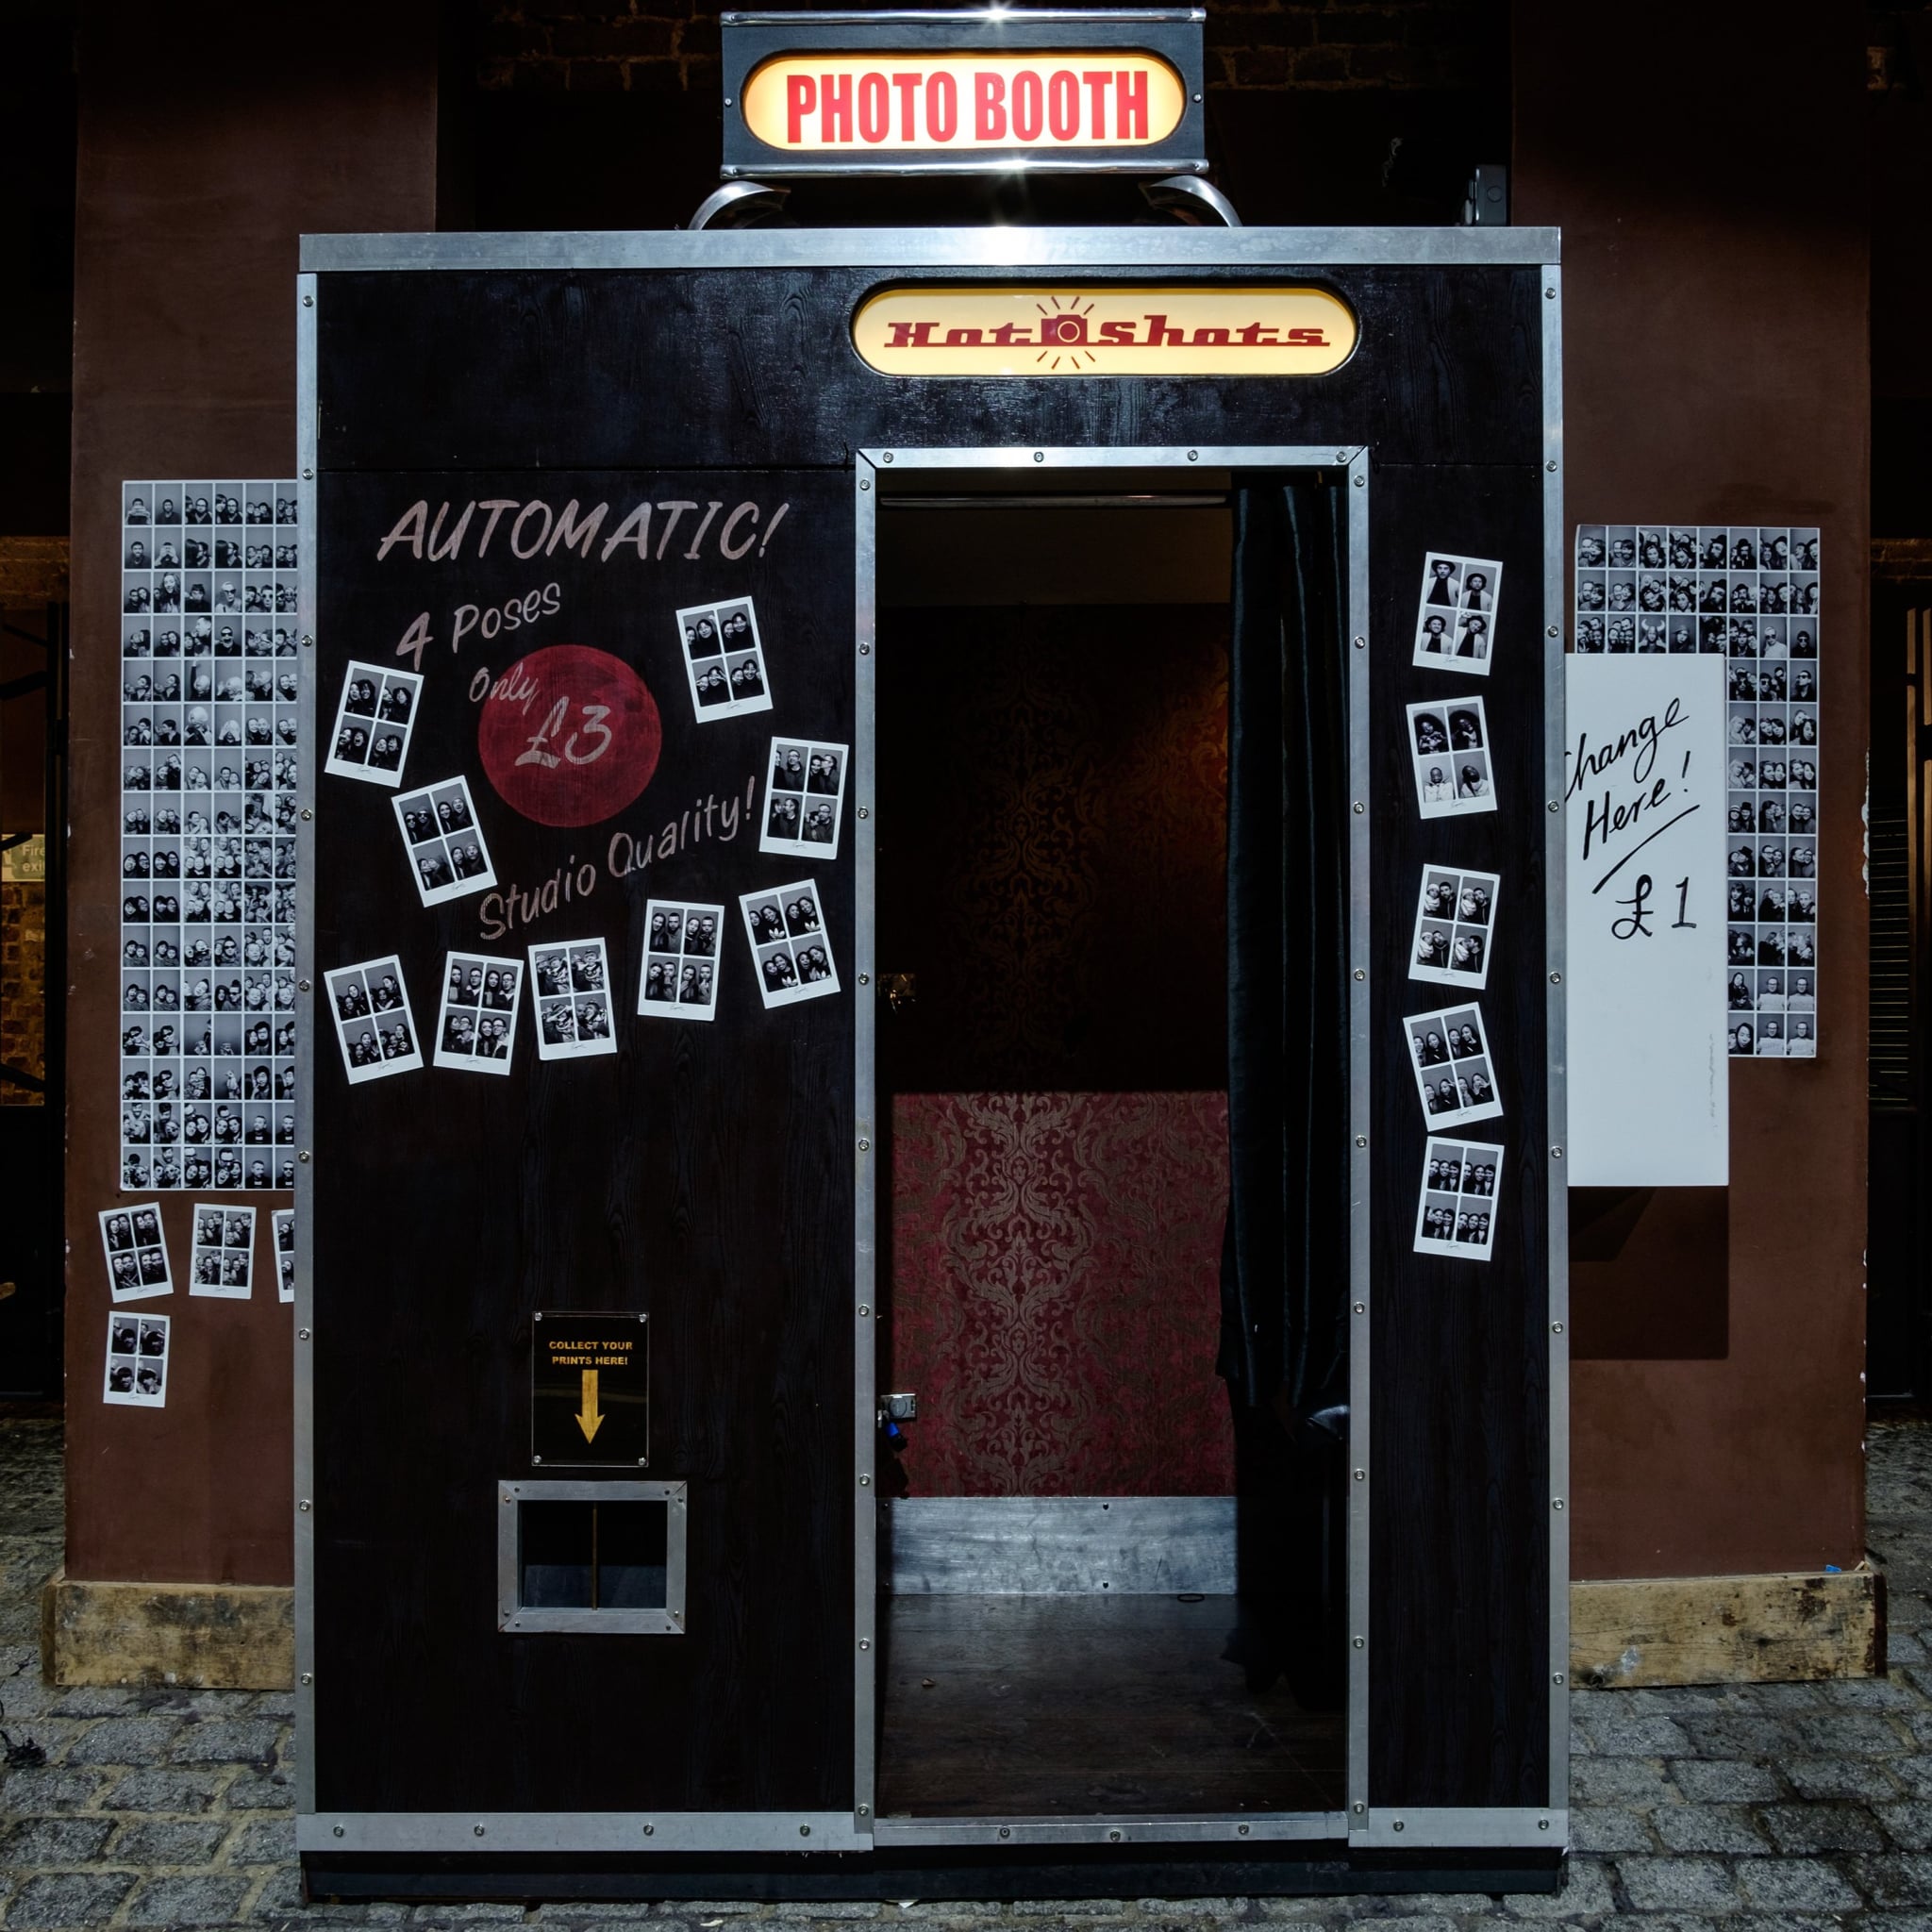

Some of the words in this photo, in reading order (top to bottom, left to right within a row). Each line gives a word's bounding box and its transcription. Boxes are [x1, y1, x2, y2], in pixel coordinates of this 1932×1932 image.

[787, 71, 958, 143] PHOTO
[974, 70, 1149, 142] BOOTH
[884, 322, 1034, 347] Hot
[1099, 314, 1331, 347] Shots
[377, 499, 790, 562] AUTOMATIC!
[396, 611, 434, 672] 4
[452, 582, 561, 653] Poses
[468, 663, 541, 712] Only
[514, 696, 612, 769] £3
[1565, 697, 1690, 802] hange
[479, 855, 597, 941] Studio
[608, 775, 756, 878] Quality!
[549, 1341, 598, 1350] COLLECT
[602, 1341, 633, 1350] YOUR
[552, 1357, 592, 1365] PRINTS
[595, 1357, 628, 1365] HERE!
